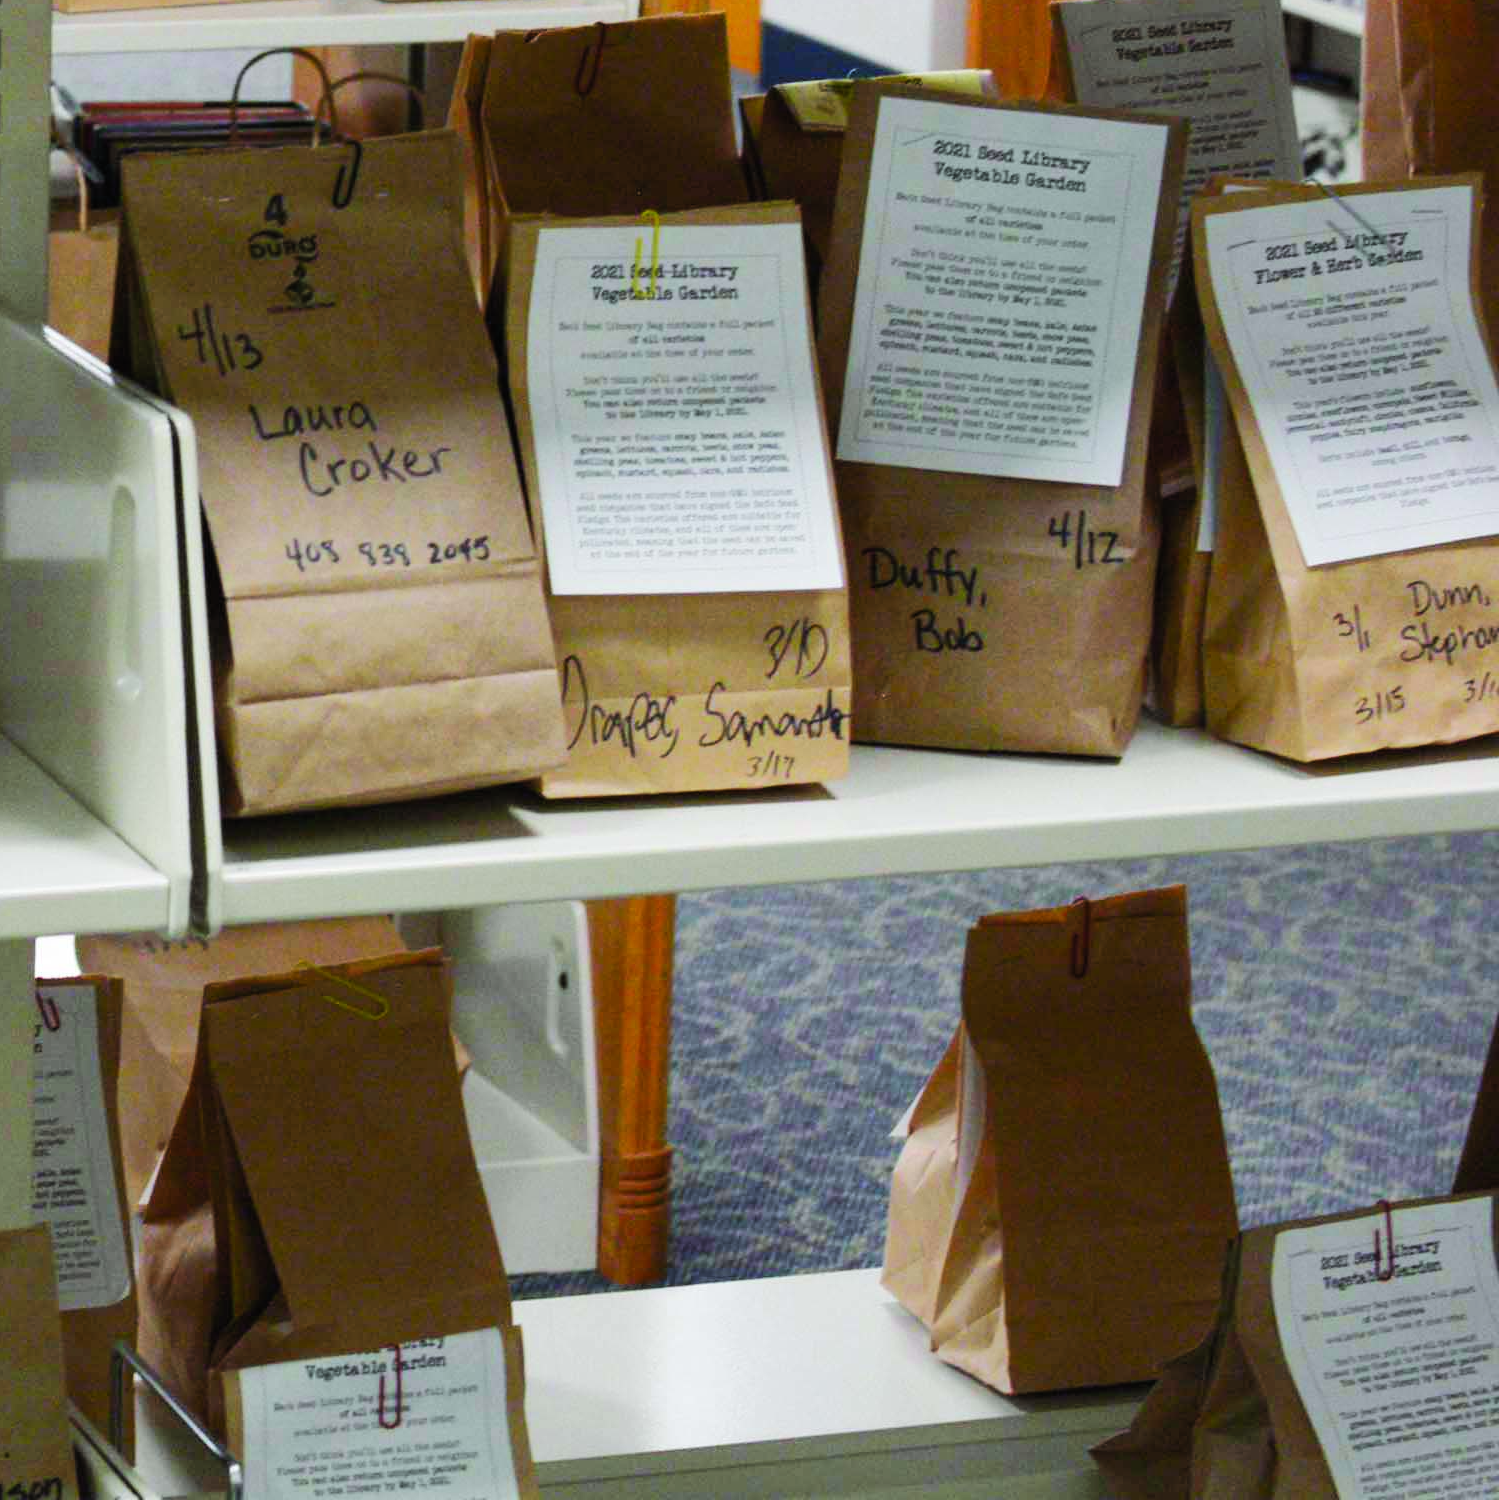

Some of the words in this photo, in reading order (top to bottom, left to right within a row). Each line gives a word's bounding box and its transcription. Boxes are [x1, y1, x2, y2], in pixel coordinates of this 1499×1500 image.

[933, 139, 972, 159] 2021
[977, 145, 1015, 163] Seed
[1020, 150, 1090, 174] Library
[934, 161, 1020, 185] Vegetable
[1025, 172, 1087, 193] Garden
[265, 193, 289, 228] 4
[591, 264, 625, 280] 2021
[671, 263, 740, 282] Library
[678, 285, 740, 301] Garden
[248, 400, 378, 441] Laura
[298, 441, 453, 497] Croker
[1048, 509, 1125, 571] 4/12
[910, 608, 986, 654] Bob
[305, 1360, 387, 1382] Vegetable
